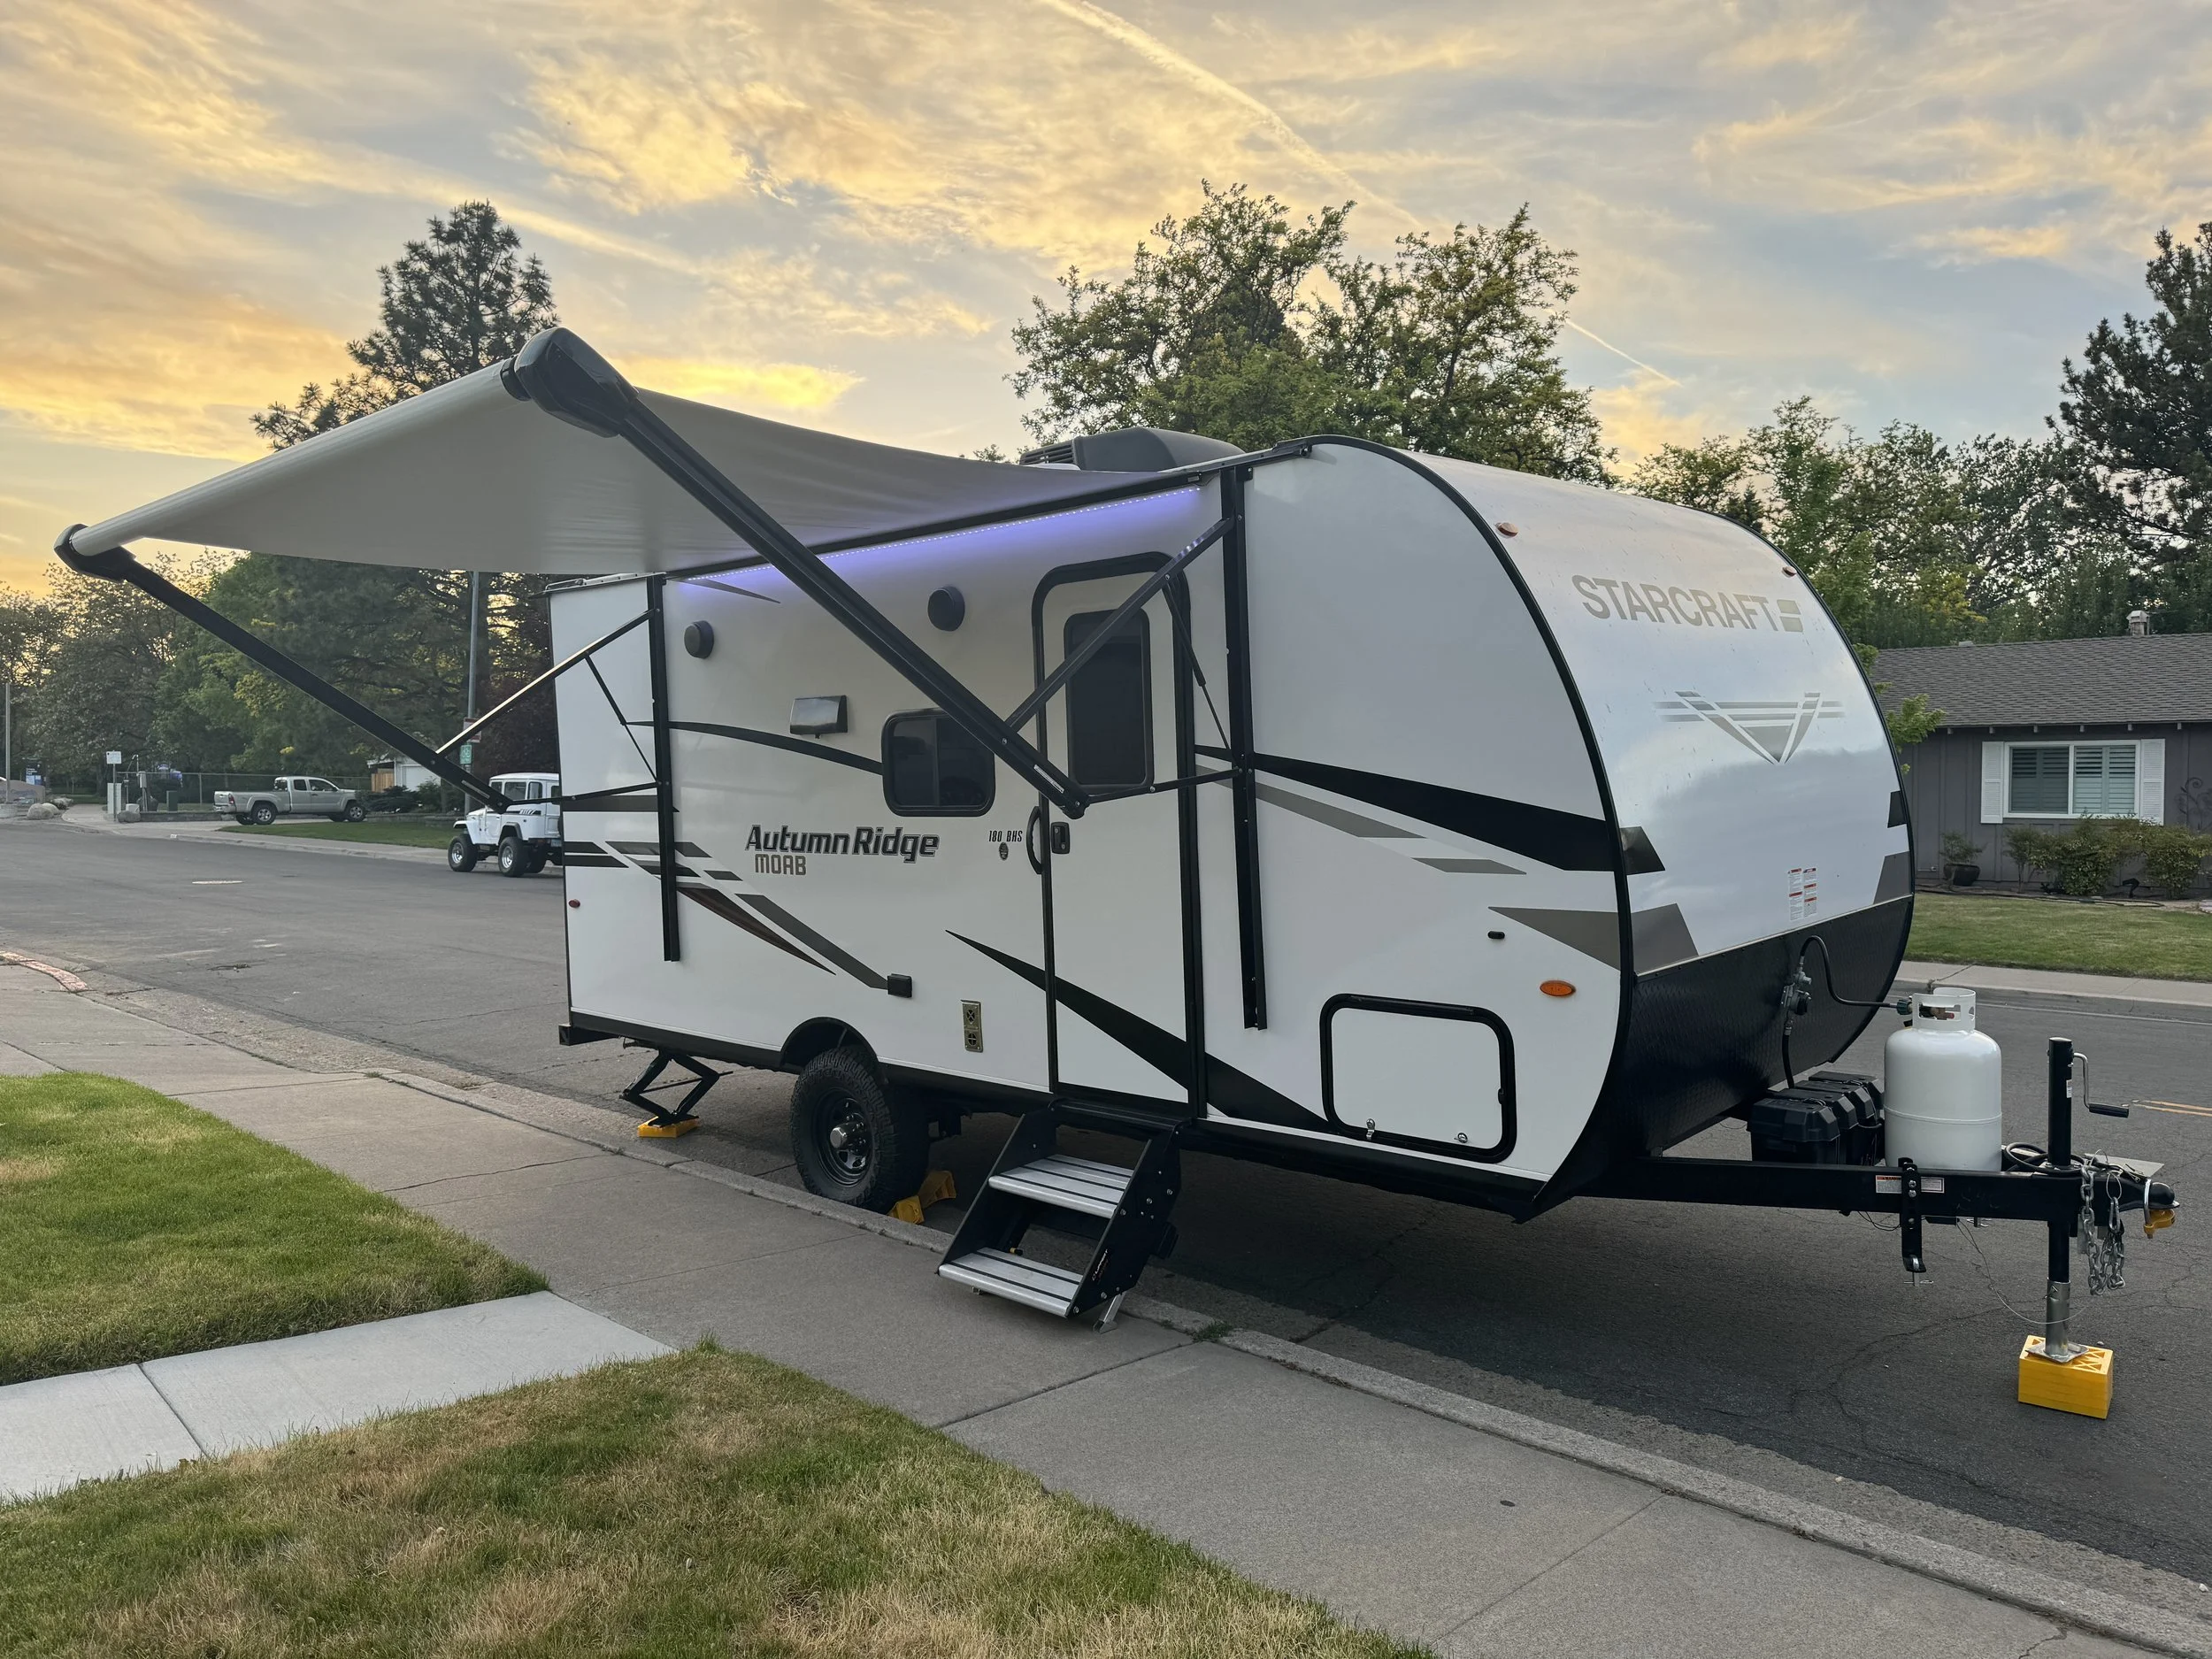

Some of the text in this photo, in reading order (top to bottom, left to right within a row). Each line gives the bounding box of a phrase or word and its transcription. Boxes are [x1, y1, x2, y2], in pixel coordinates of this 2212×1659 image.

[1572, 575, 1778, 631] STARCRAFT
[745, 825, 940, 864] Autumn Ridge
[988, 830, 1023, 842] 180 BHS
[755, 853, 806, 875] MOAB
